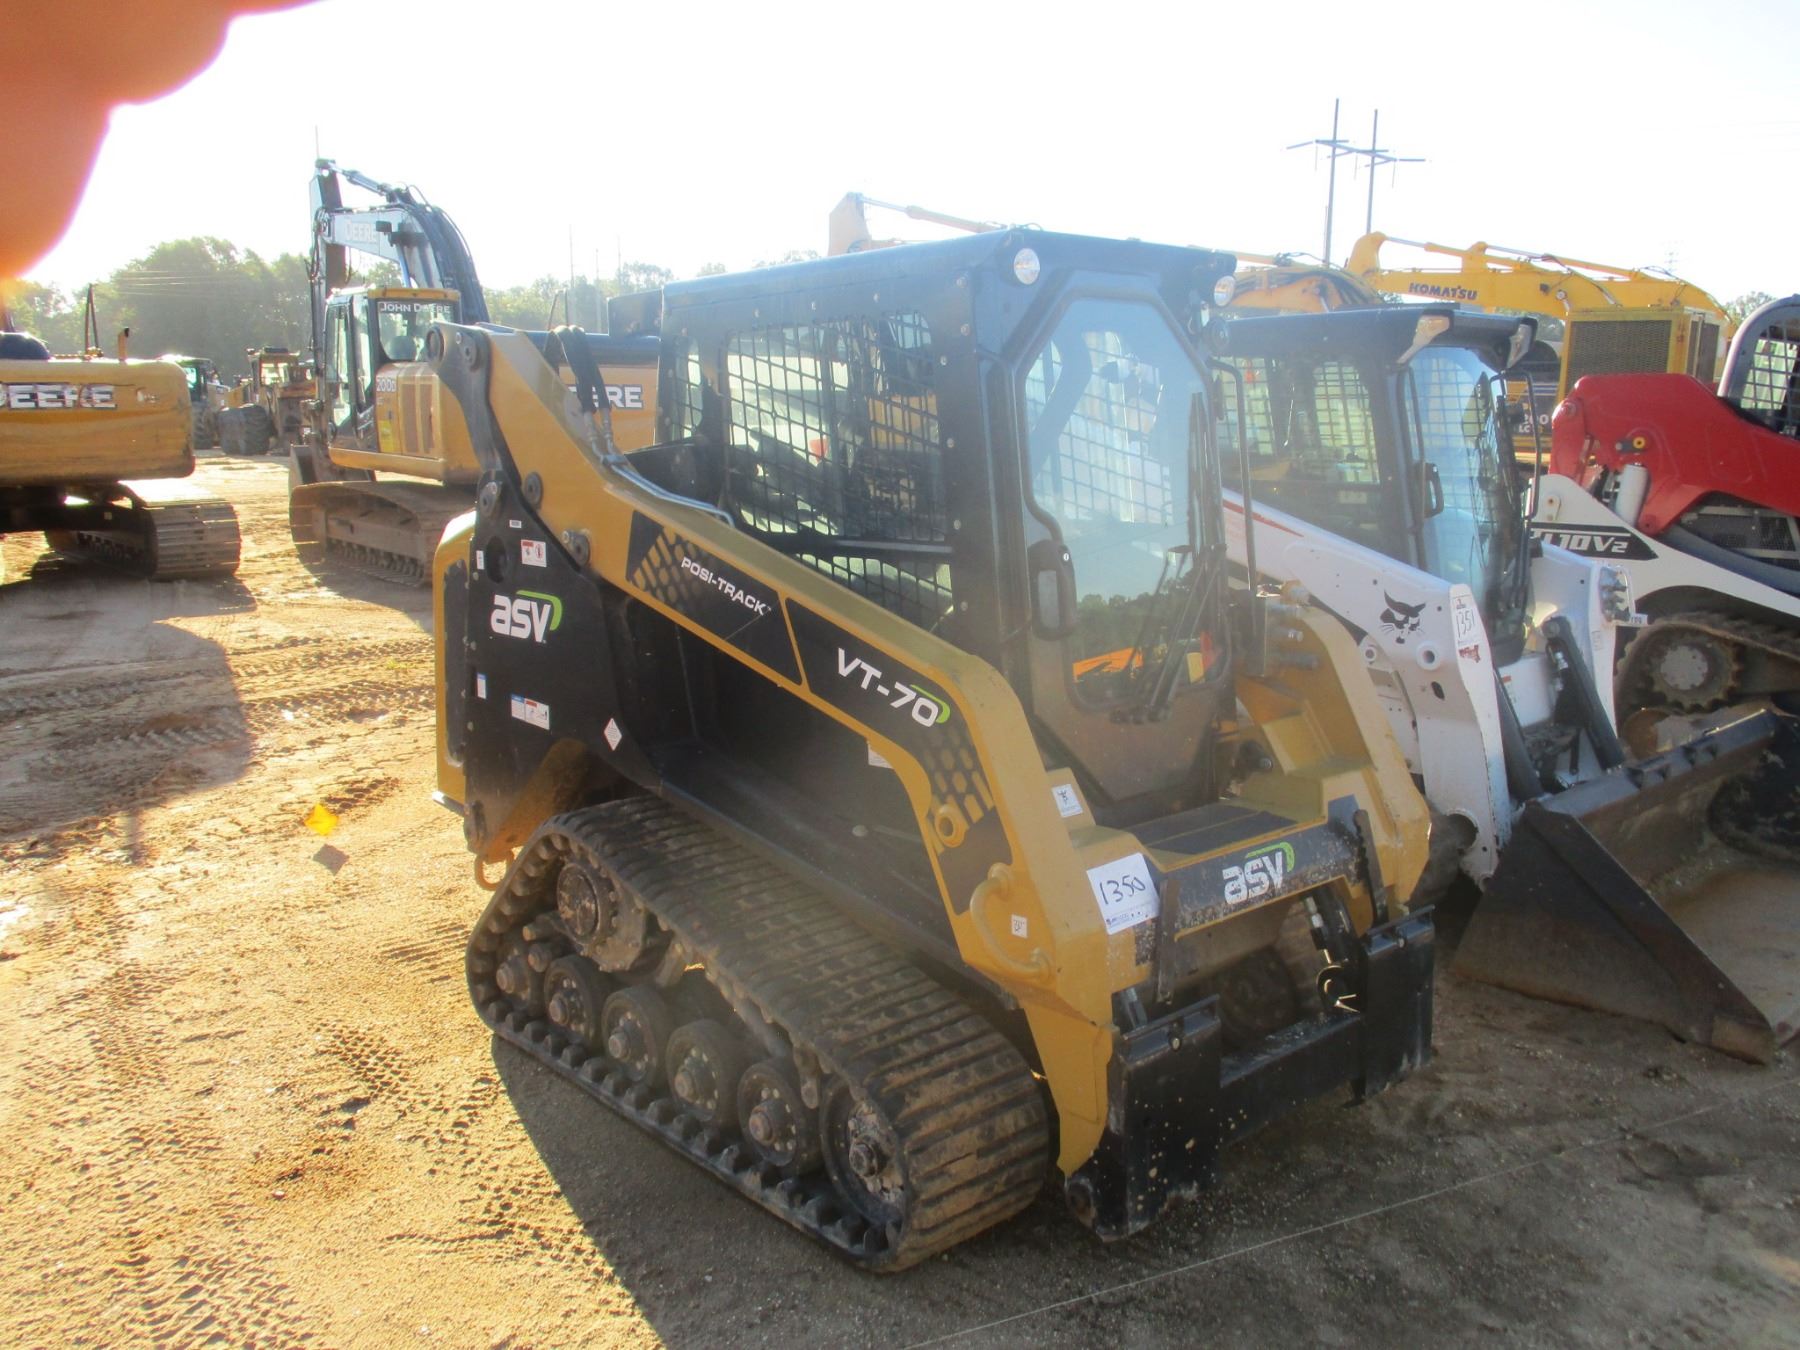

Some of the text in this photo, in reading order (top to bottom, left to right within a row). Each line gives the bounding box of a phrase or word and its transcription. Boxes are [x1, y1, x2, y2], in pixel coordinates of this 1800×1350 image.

[1408, 283, 1478, 300] KOMATSU
[380, 303, 450, 313] JOHN DEERE
[0, 384, 117, 408] EERE
[681, 557, 764, 616] POSI-TRACK
[838, 647, 939, 728] VT-70
[1099, 875, 1146, 905] 1350
